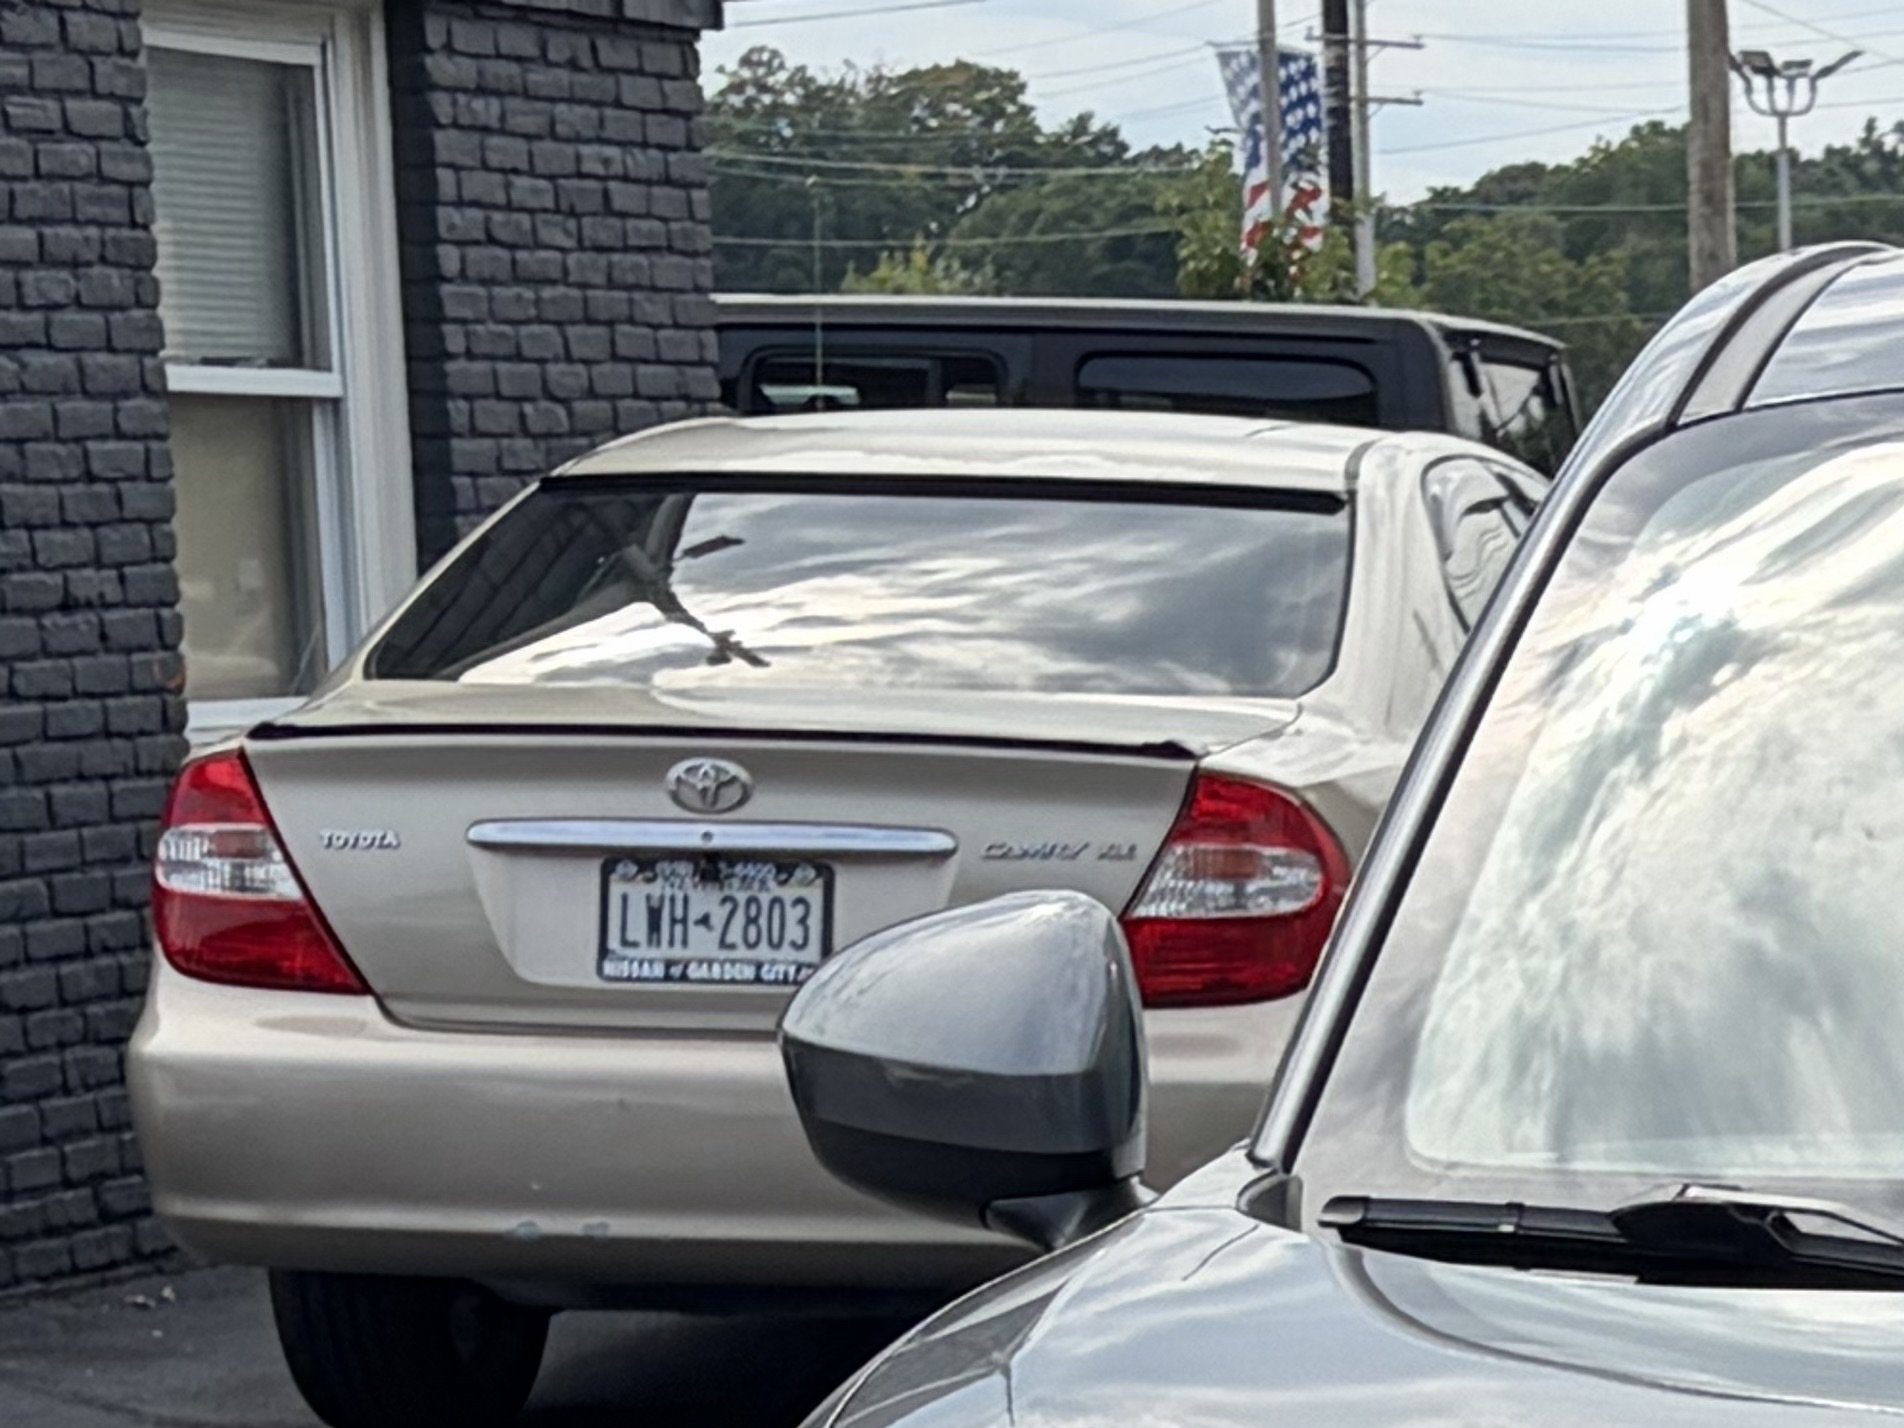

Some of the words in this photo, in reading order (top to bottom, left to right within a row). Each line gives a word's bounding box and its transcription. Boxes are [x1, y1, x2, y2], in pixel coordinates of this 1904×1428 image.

[320, 829, 401, 850] TOYOTA
[619, 891, 690, 949] LWH
[717, 894, 812, 951] 2803
